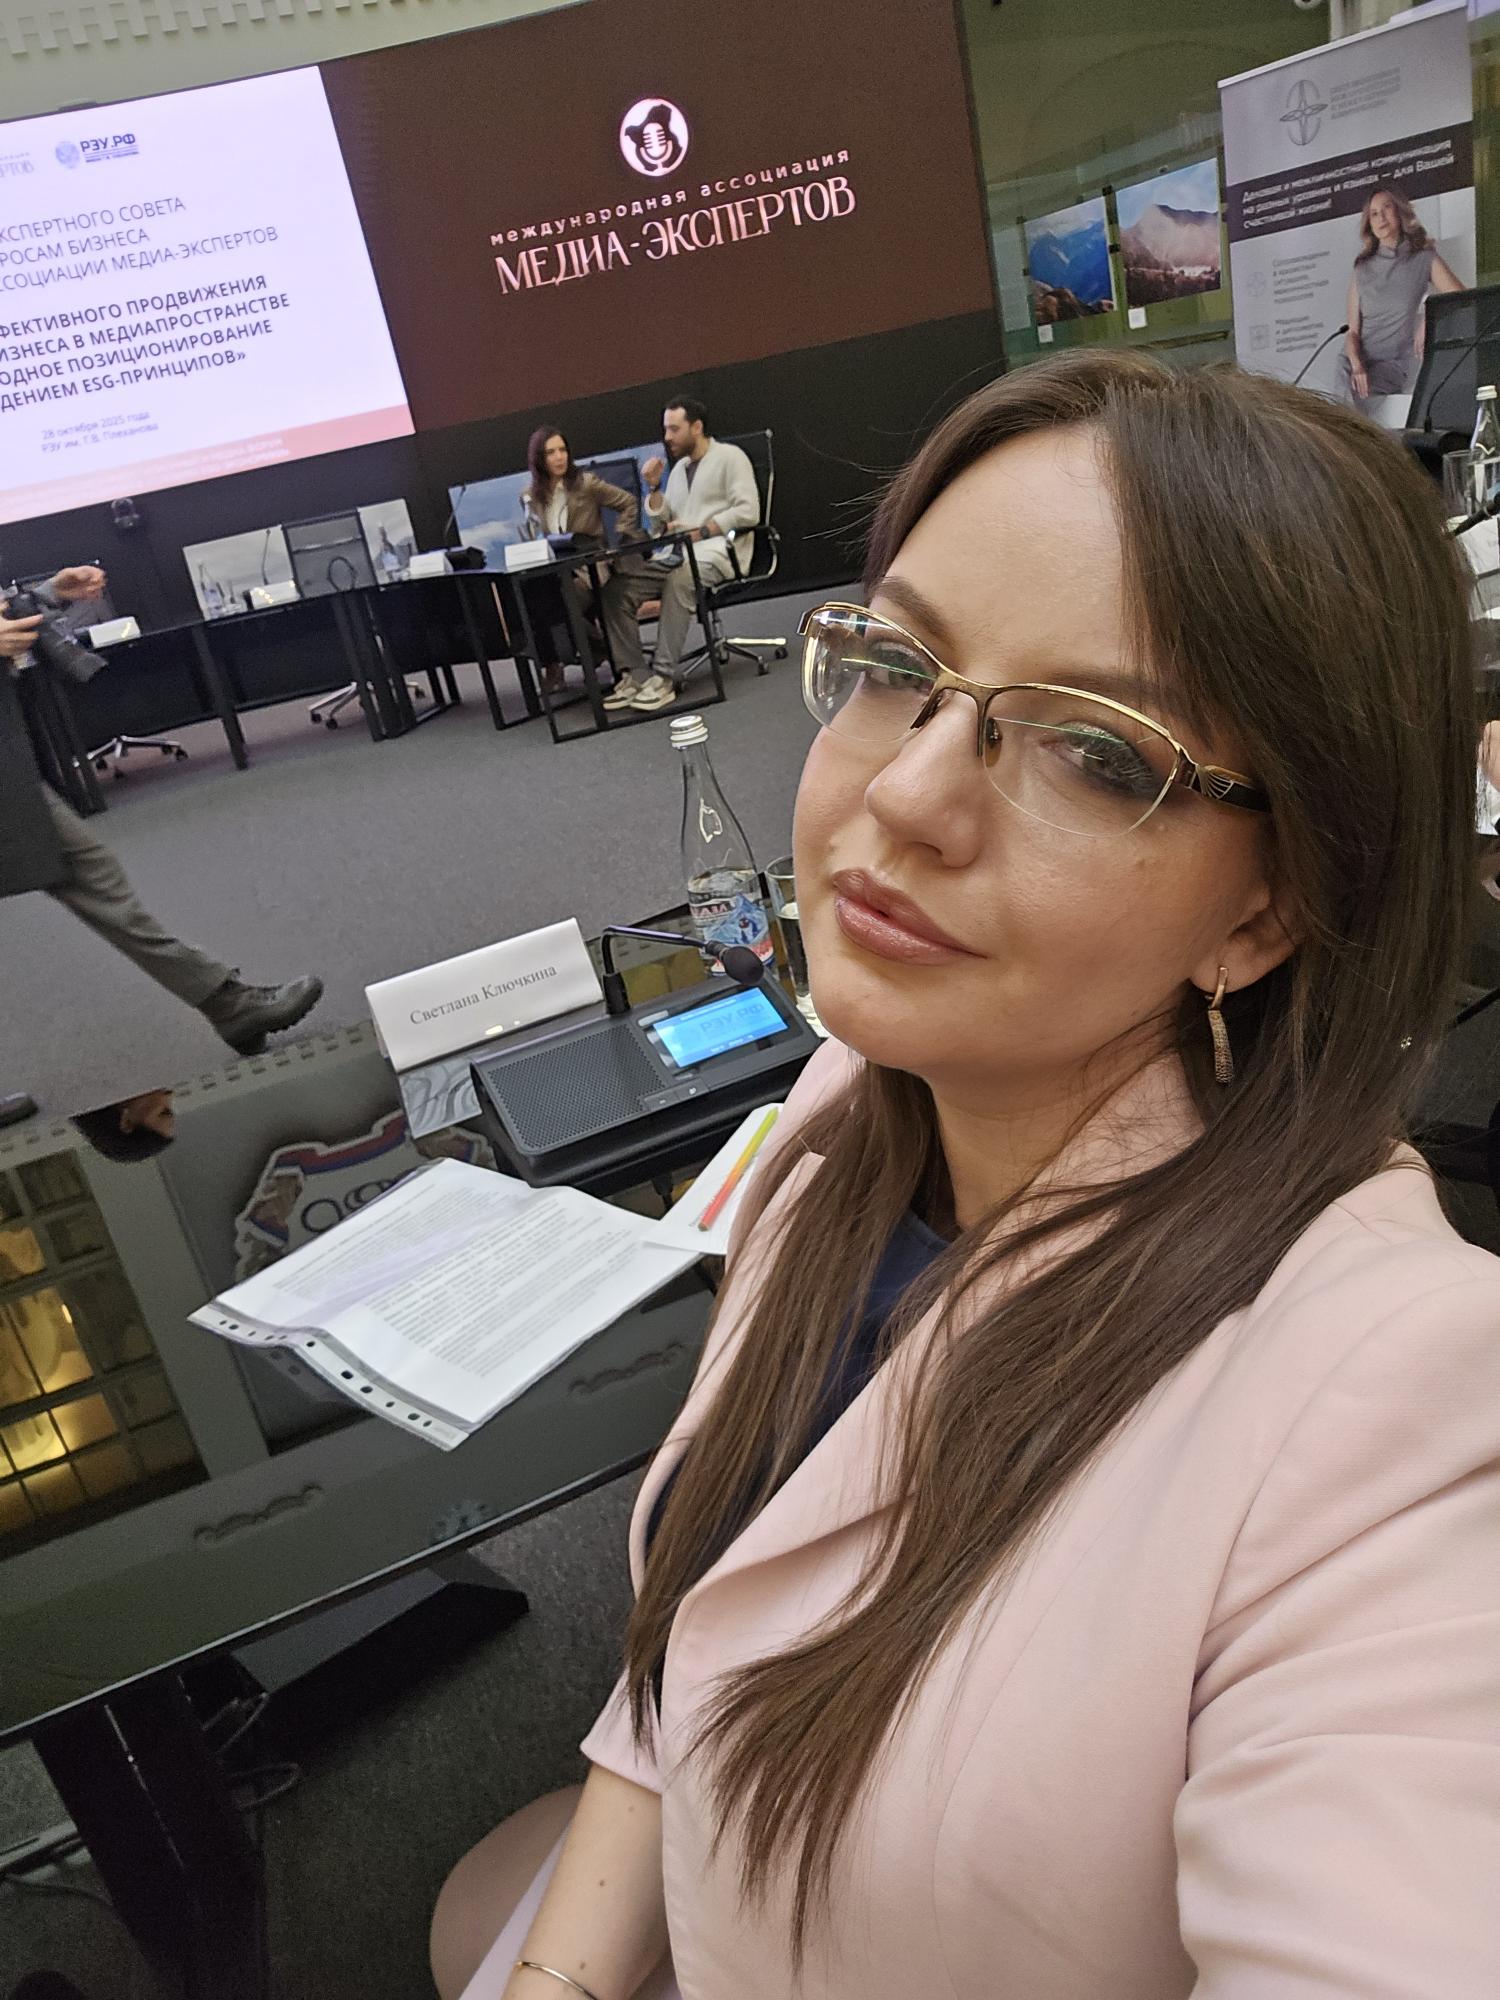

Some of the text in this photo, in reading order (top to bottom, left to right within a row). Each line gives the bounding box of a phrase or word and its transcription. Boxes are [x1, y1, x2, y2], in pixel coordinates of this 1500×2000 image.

[119, 197, 186, 222] СОВЕТА
[491, 149, 850, 246] международная ассоциация
[0, 226, 278, 292] СОЦИАЦИИ МЕДИА-ЭКСПЕРТОВ
[68, 228, 150, 255] БИЗНЕСА
[495, 176, 857, 294] МЕДИА-ЭКСПЕРТОВ
[73, 334, 85, 349] В
[89, 293, 290, 345] МЕДИАПРОСТРАНСТВЕ
[126, 275, 267, 315] ПРОДВИЖЕНИЯ
[0, 320, 273, 387] ОДНОЕ ПОЗИЦИОНИРОВАНИЕ
[1, 350, 246, 412] ДЕНИЕМ ESG-ПРИНЦИПОВ»
[410, 966, 557, 1024] Светлана Ключкина
